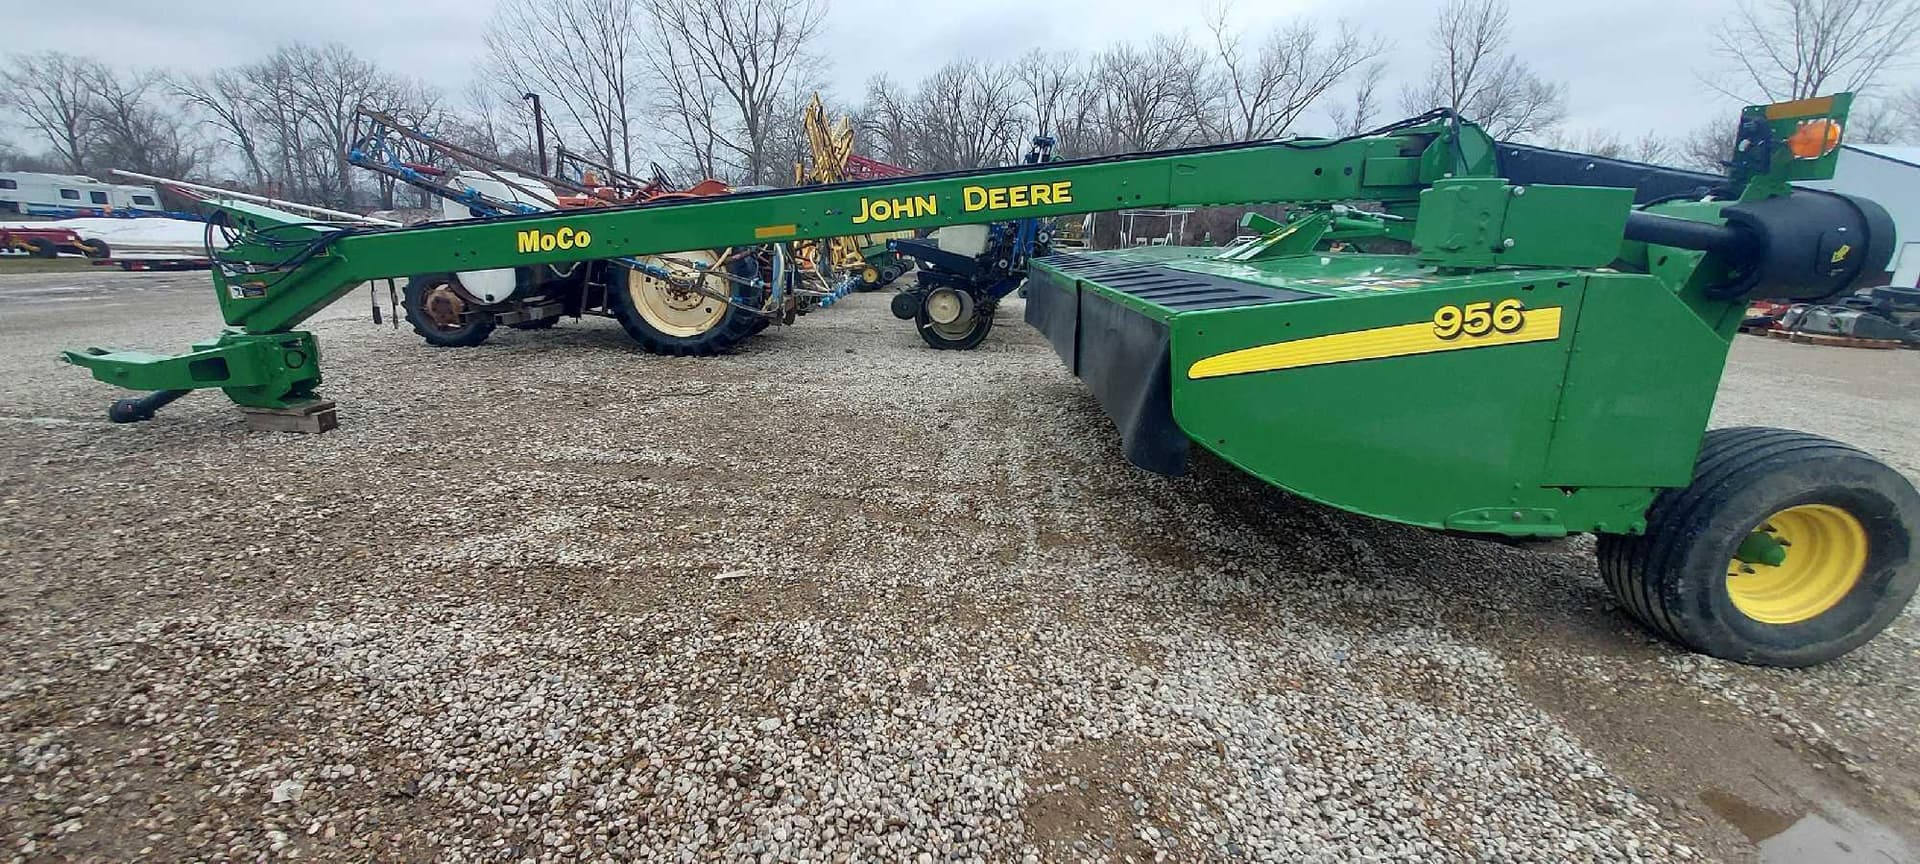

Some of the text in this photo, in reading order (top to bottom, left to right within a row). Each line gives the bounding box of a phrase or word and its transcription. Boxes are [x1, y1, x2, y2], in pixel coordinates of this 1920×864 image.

[852, 181, 1073, 224] JOHN DEERE
[517, 226, 592, 253] MoCo
[1433, 298, 1523, 339] 956
